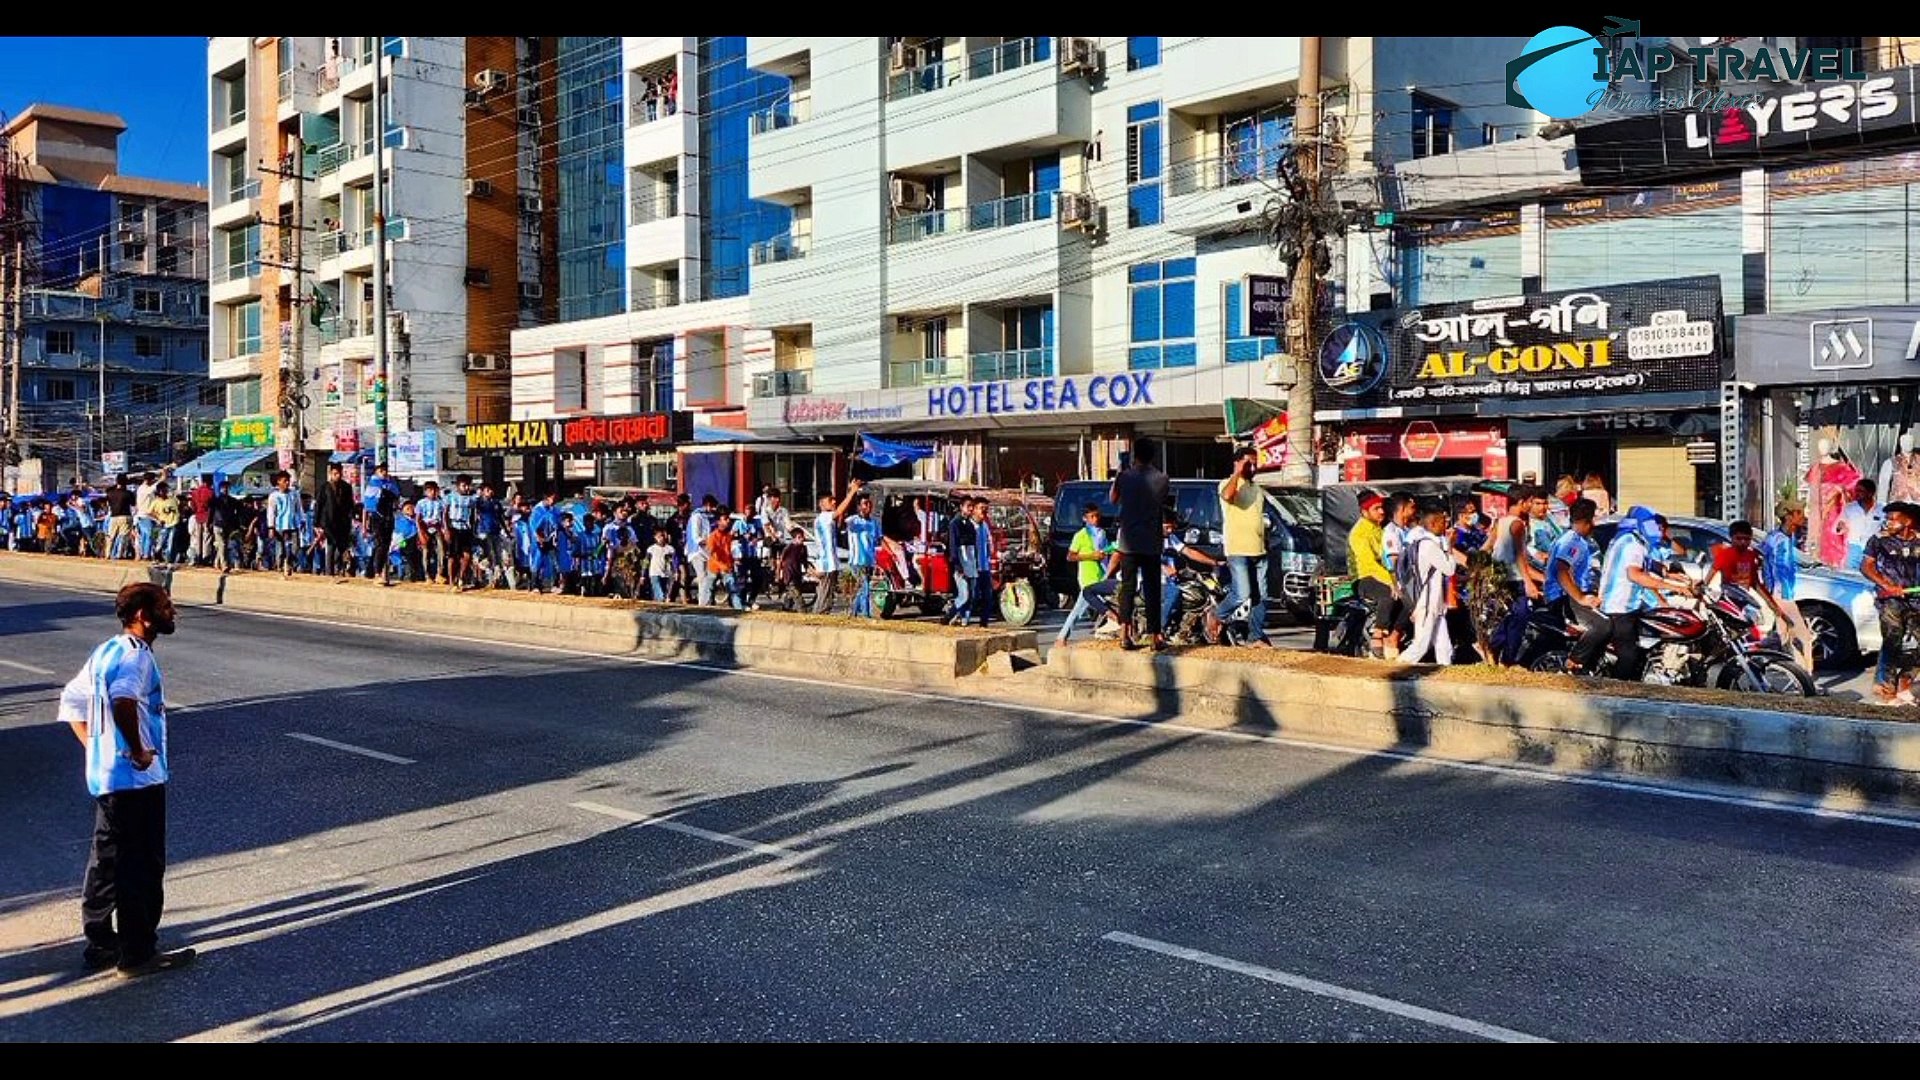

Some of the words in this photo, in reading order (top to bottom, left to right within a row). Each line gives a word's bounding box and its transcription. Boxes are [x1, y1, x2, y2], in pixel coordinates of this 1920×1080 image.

[1416, 337, 1613, 379] AL-GONI
[928, 380, 1014, 416] HOTEL
[1024, 378, 1079, 411] SEA
[1088, 371, 1154, 408] COX
[466, 423, 509, 448] MARINE
[509, 421, 548, 447] PLAZA
